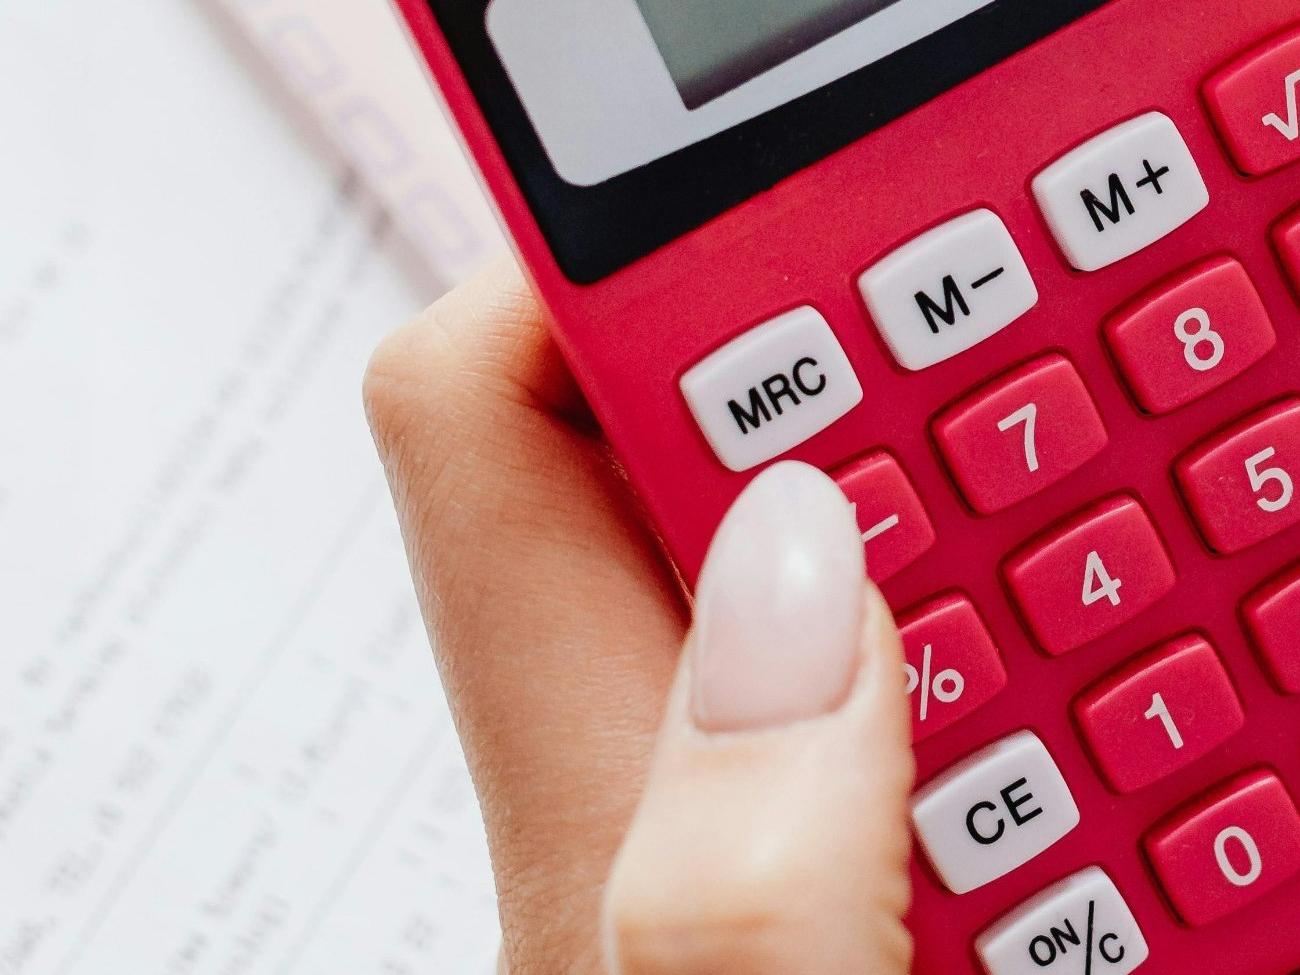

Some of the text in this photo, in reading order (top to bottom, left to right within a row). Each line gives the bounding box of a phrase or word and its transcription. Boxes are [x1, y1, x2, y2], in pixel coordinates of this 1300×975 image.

[1080, 160, 1169, 232] M+
[914, 267, 1004, 333] M-
[1174, 308, 1224, 371] 8
[728, 357, 826, 434] MRC
[998, 403, 1038, 471] 7
[1245, 447, 1293, 512] 5
[1082, 551, 1121, 605] 4
[1145, 693, 1183, 748] 1
[966, 777, 1043, 844] CE
[1214, 827, 1261, 885] 0
[1029, 901, 1124, 975] ON/C
